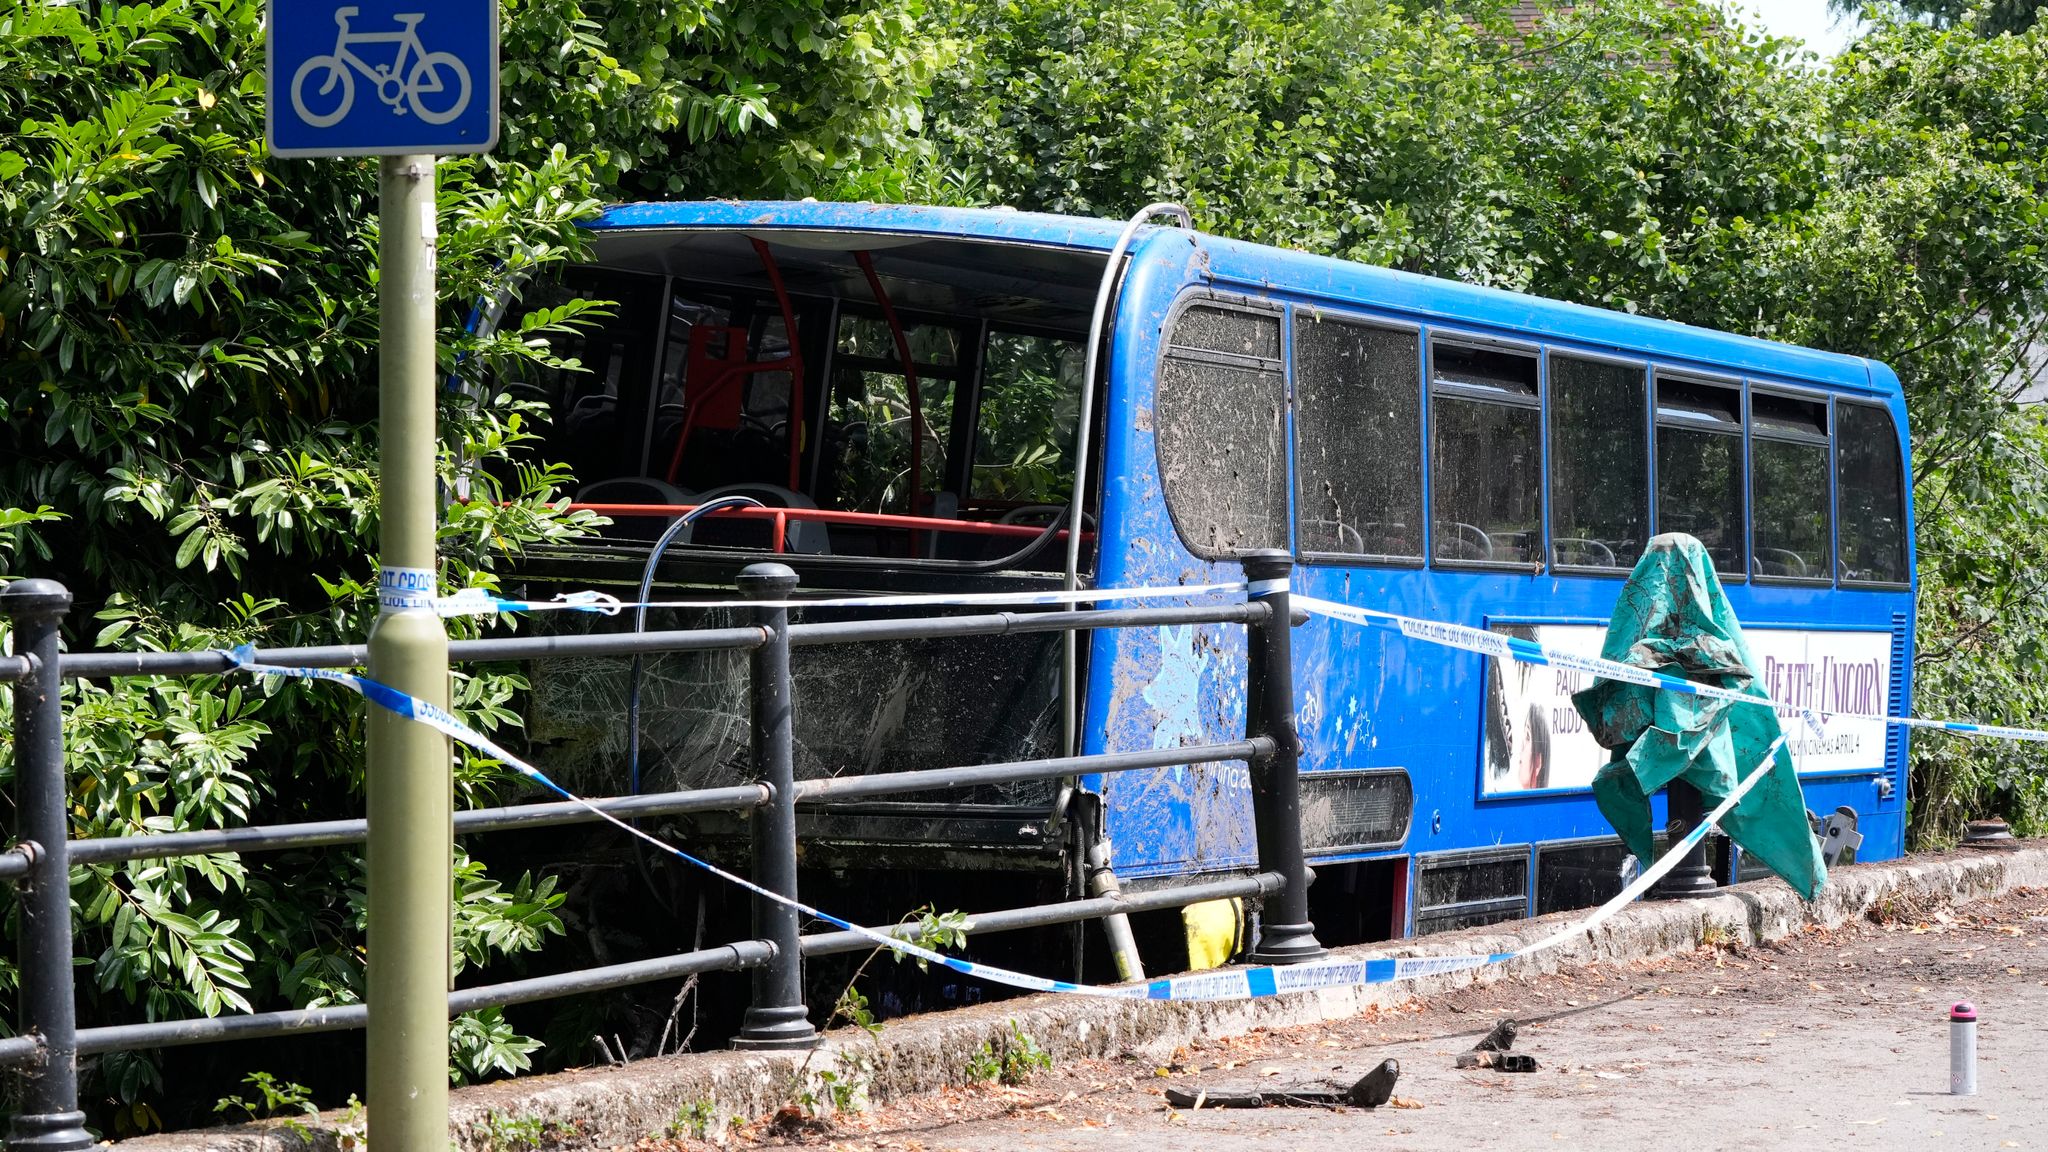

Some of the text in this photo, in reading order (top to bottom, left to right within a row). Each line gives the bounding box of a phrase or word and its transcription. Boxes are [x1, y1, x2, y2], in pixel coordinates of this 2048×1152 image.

[1764, 655, 1814, 718] DEATH
[1821, 655, 1885, 724] UNICORN
[1552, 707, 1583, 734] RUDD
[1788, 739, 1801, 757] NLY
[1808, 737, 1834, 756] CINEMAS
[1835, 733, 1854, 754] APRIL
[1854, 733, 1860, 753] 4
[1323, 966, 1340, 985] LINE
[1338, 964, 1364, 984] POLICE
